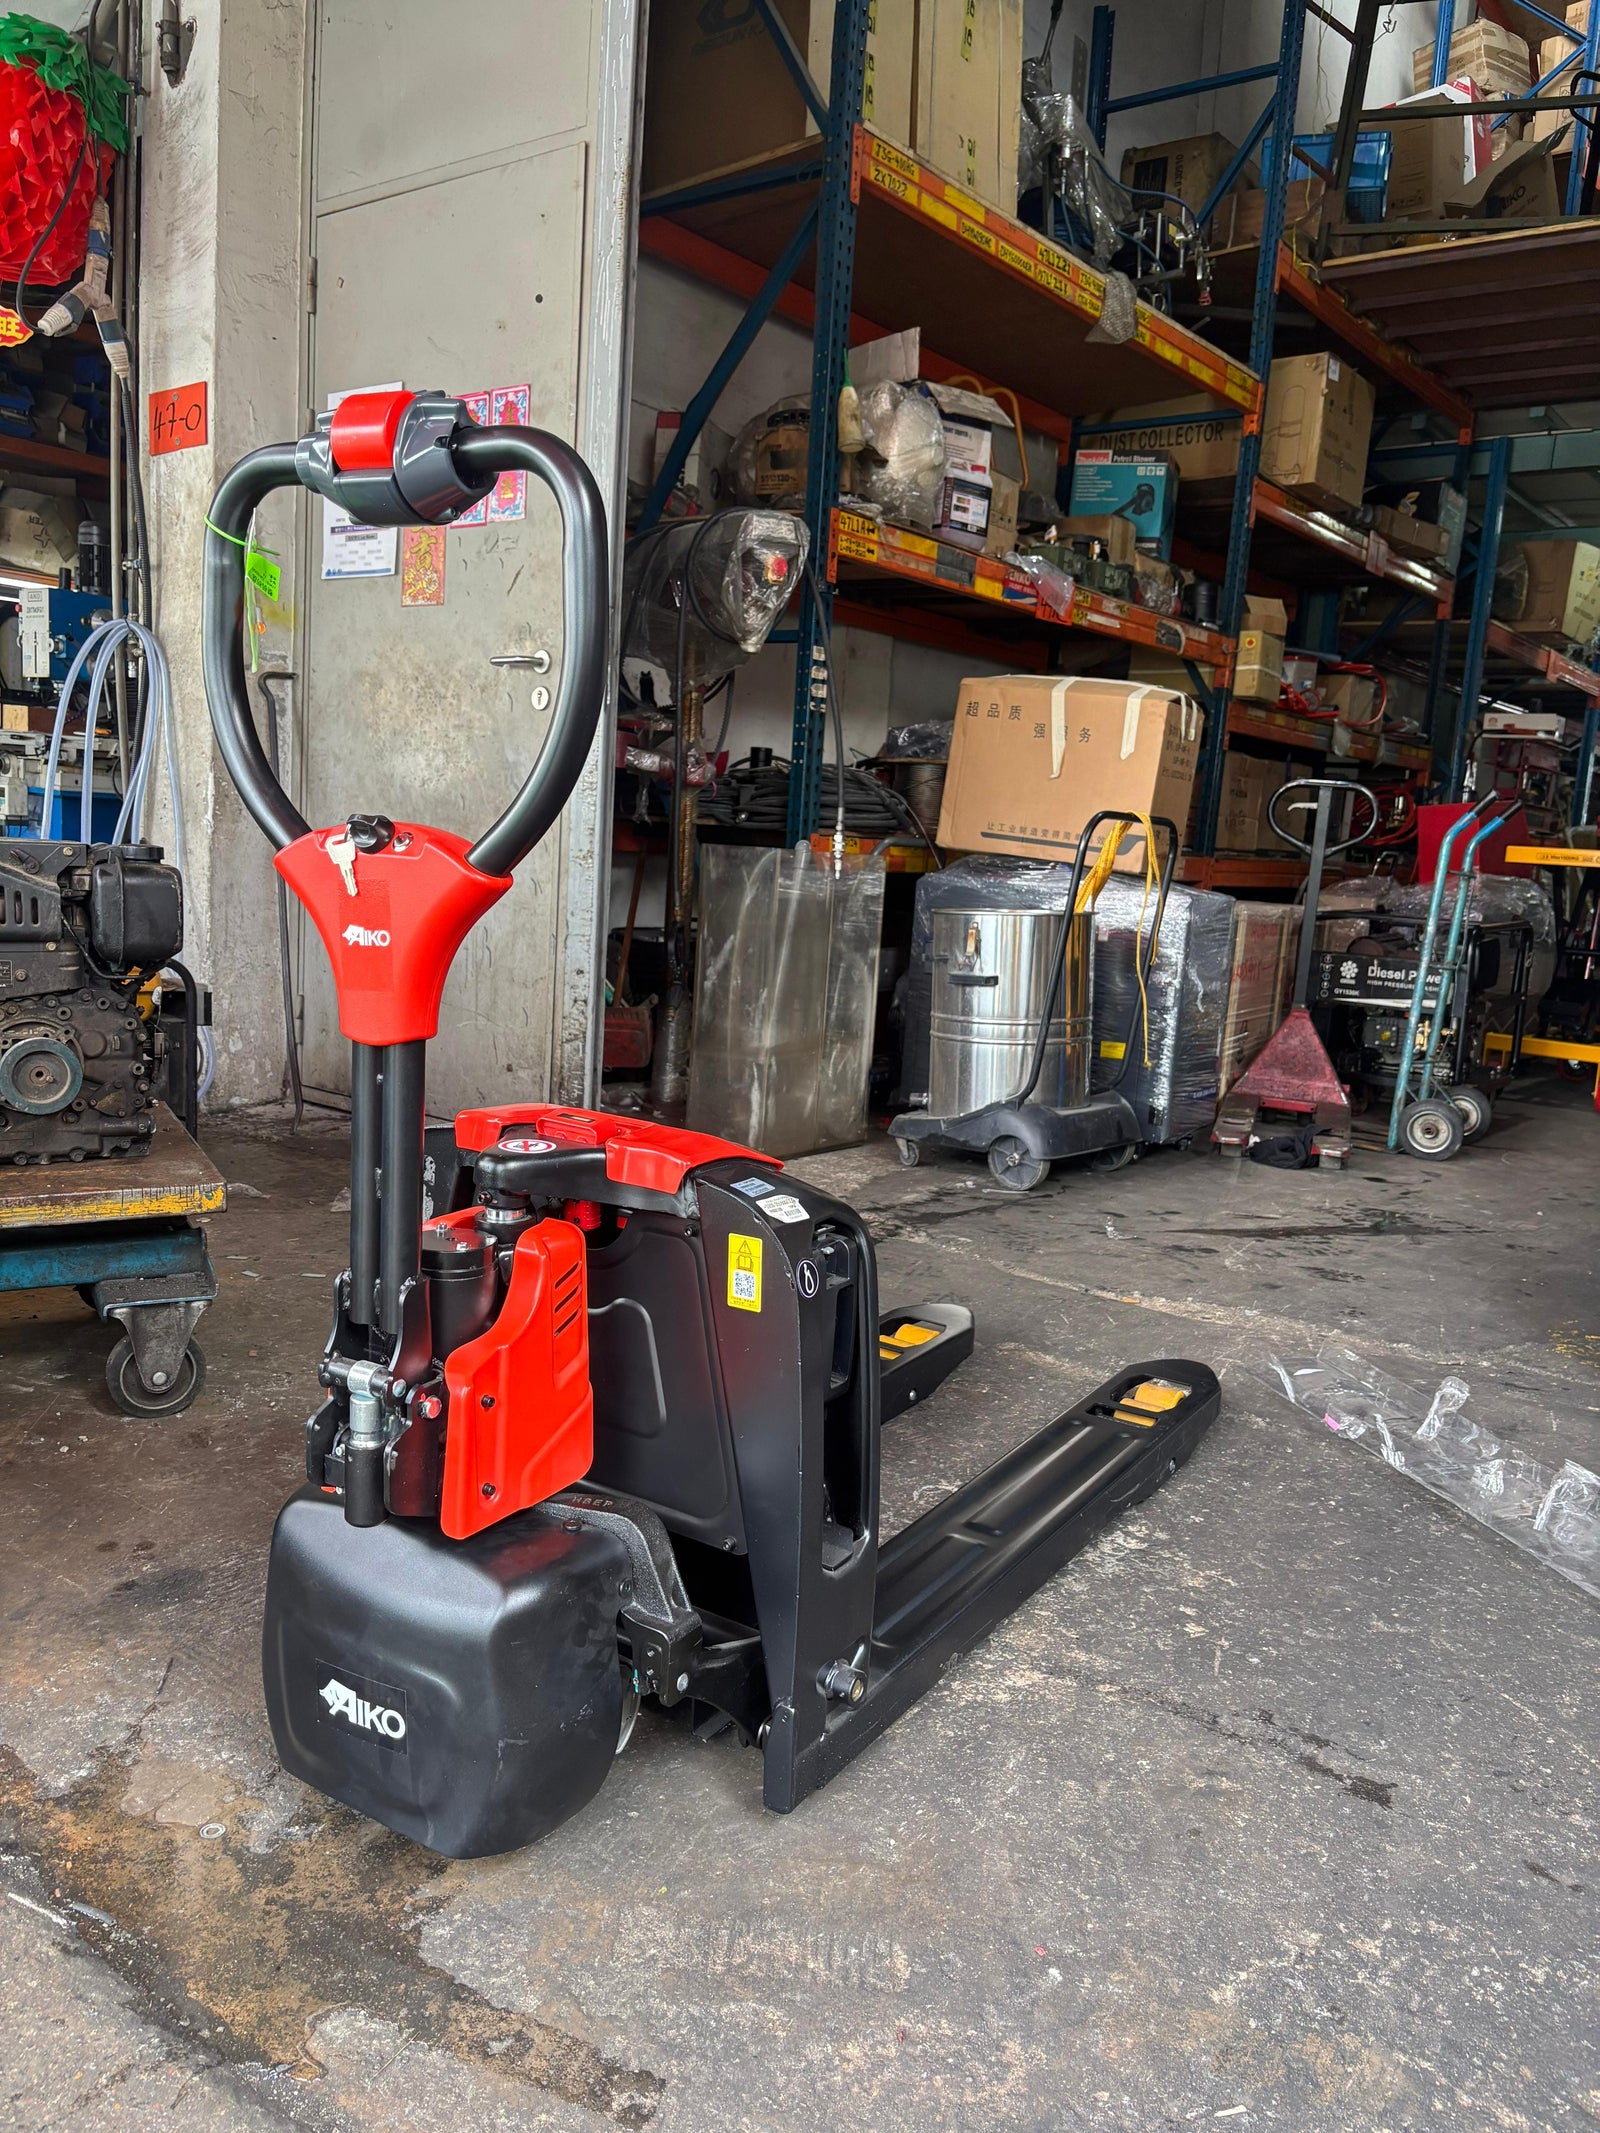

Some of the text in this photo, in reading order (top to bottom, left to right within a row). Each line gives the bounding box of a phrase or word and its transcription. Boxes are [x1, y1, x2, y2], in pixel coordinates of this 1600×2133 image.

[153, 401, 202, 440] 47-0
[1100, 421, 1225, 451] DUST COLLECTOR
[965, 700, 1022, 722] 超品质
[1033, 722, 1092, 744] 强务
[341, 924, 391, 947] AIKO
[1367, 965, 1405, 982] Diesel
[1407, 969, 1444, 986] Pwe
[319, 1678, 407, 1740] AIKO
